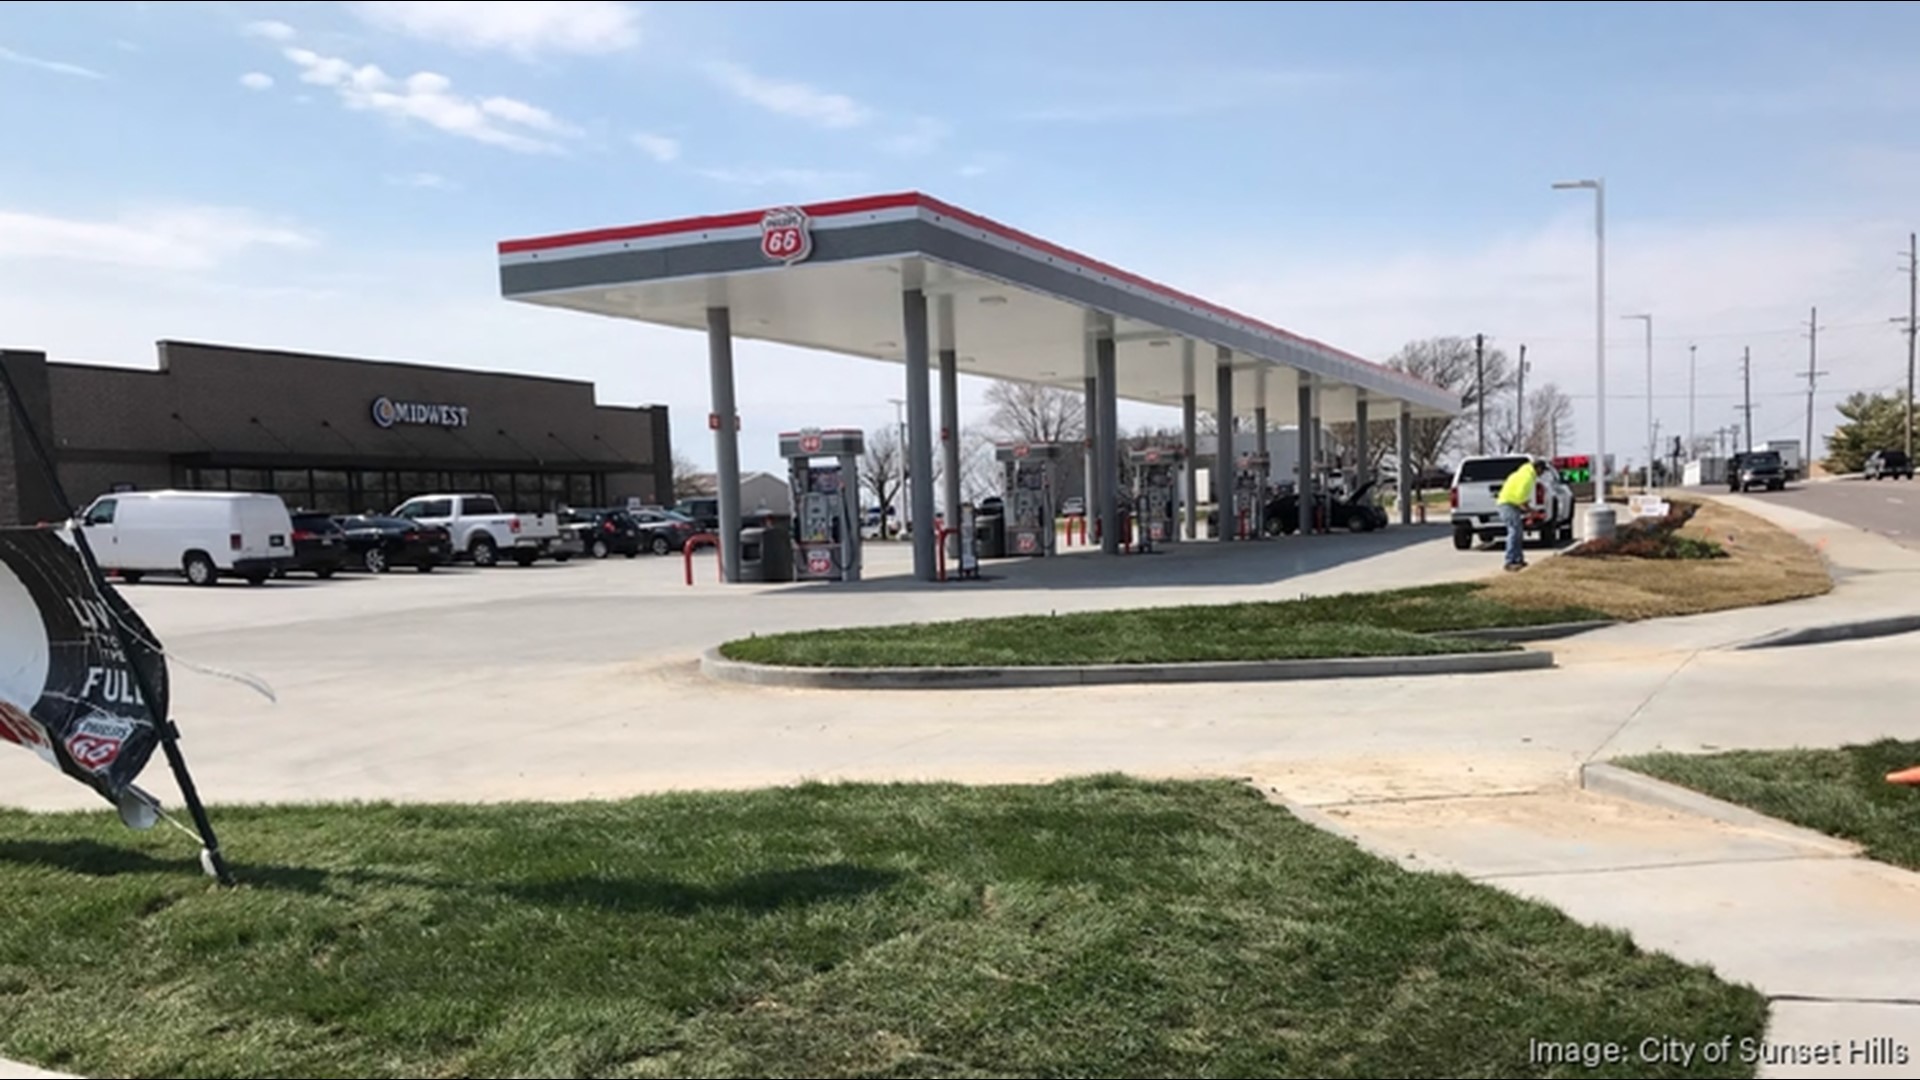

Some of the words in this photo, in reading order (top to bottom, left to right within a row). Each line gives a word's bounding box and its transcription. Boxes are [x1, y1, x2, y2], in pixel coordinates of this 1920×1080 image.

[769, 230, 797, 252] 66
[393, 402, 469, 427] MIDWEST
[73, 739, 116, 763] 66
